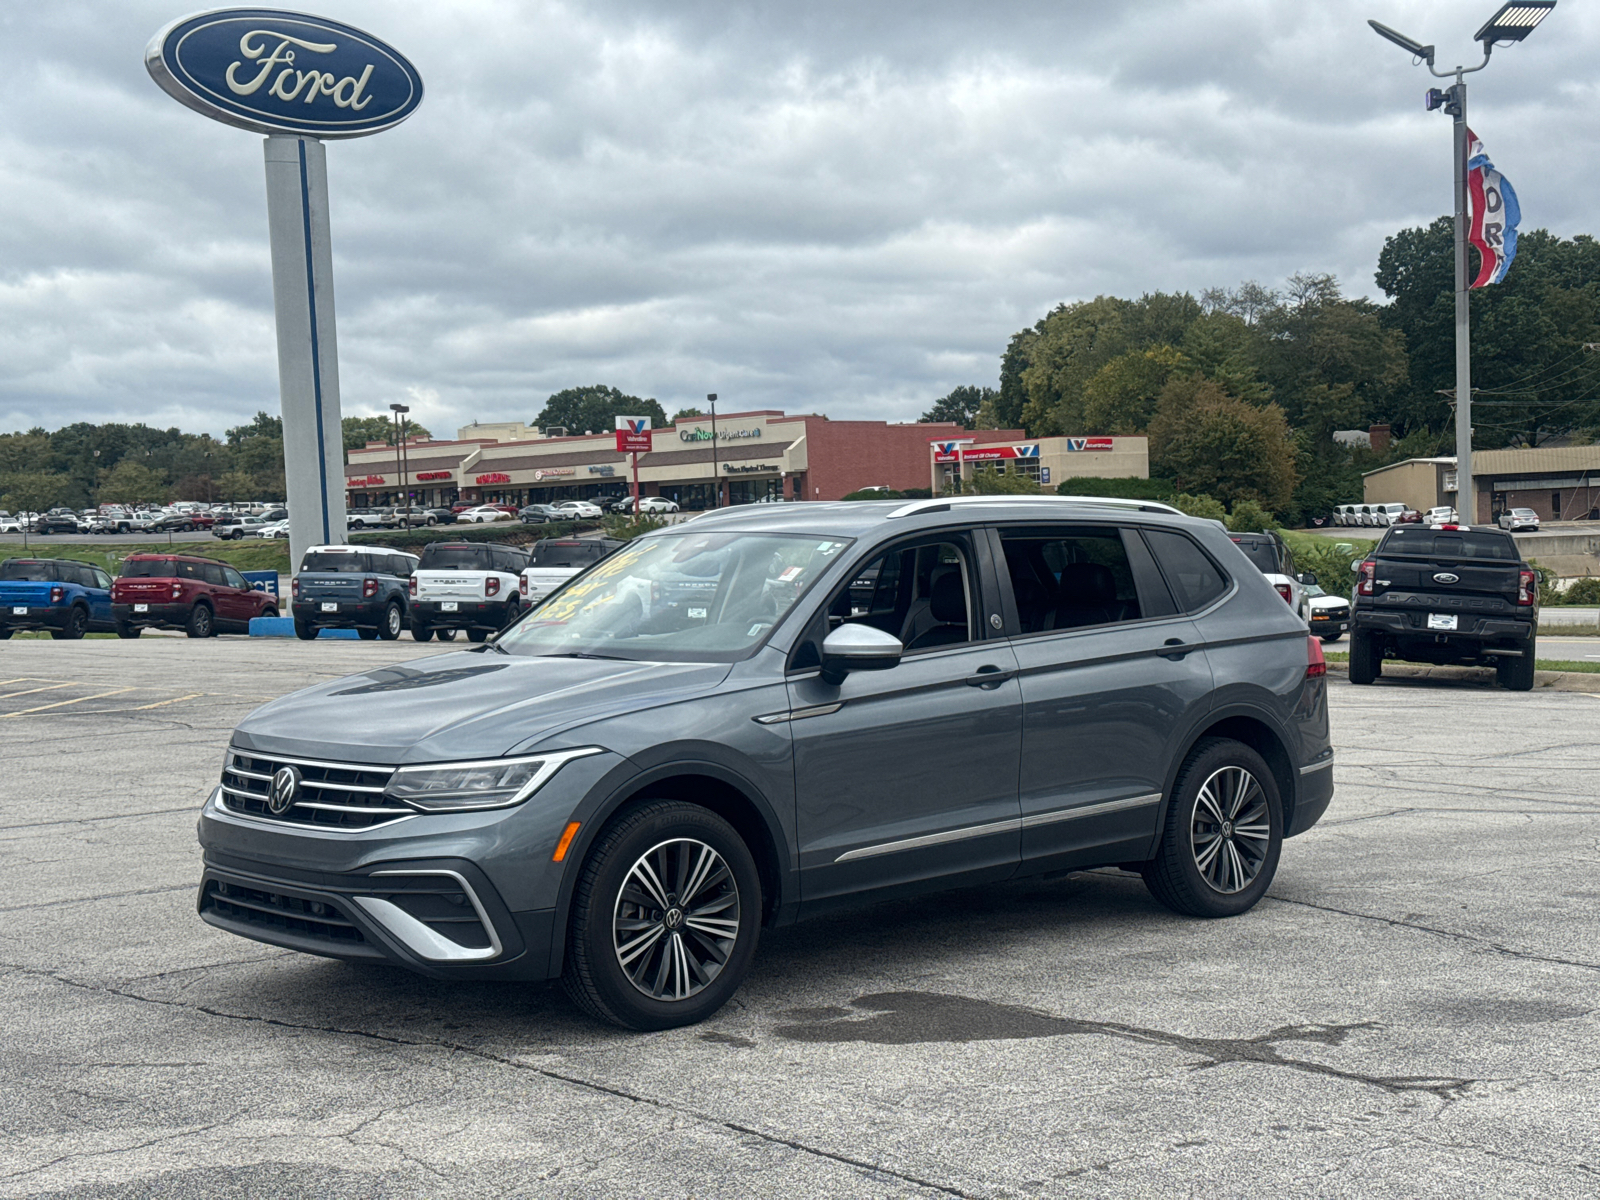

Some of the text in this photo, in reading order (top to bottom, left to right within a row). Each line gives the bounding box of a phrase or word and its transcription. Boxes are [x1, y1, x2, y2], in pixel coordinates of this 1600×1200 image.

[225, 29, 375, 111] Ford
[718, 430, 739, 441] Urgent
[739, 429, 753, 438] Care
[347, 476, 366, 487] Jersey
[1386, 594, 1505, 610] RANGER
